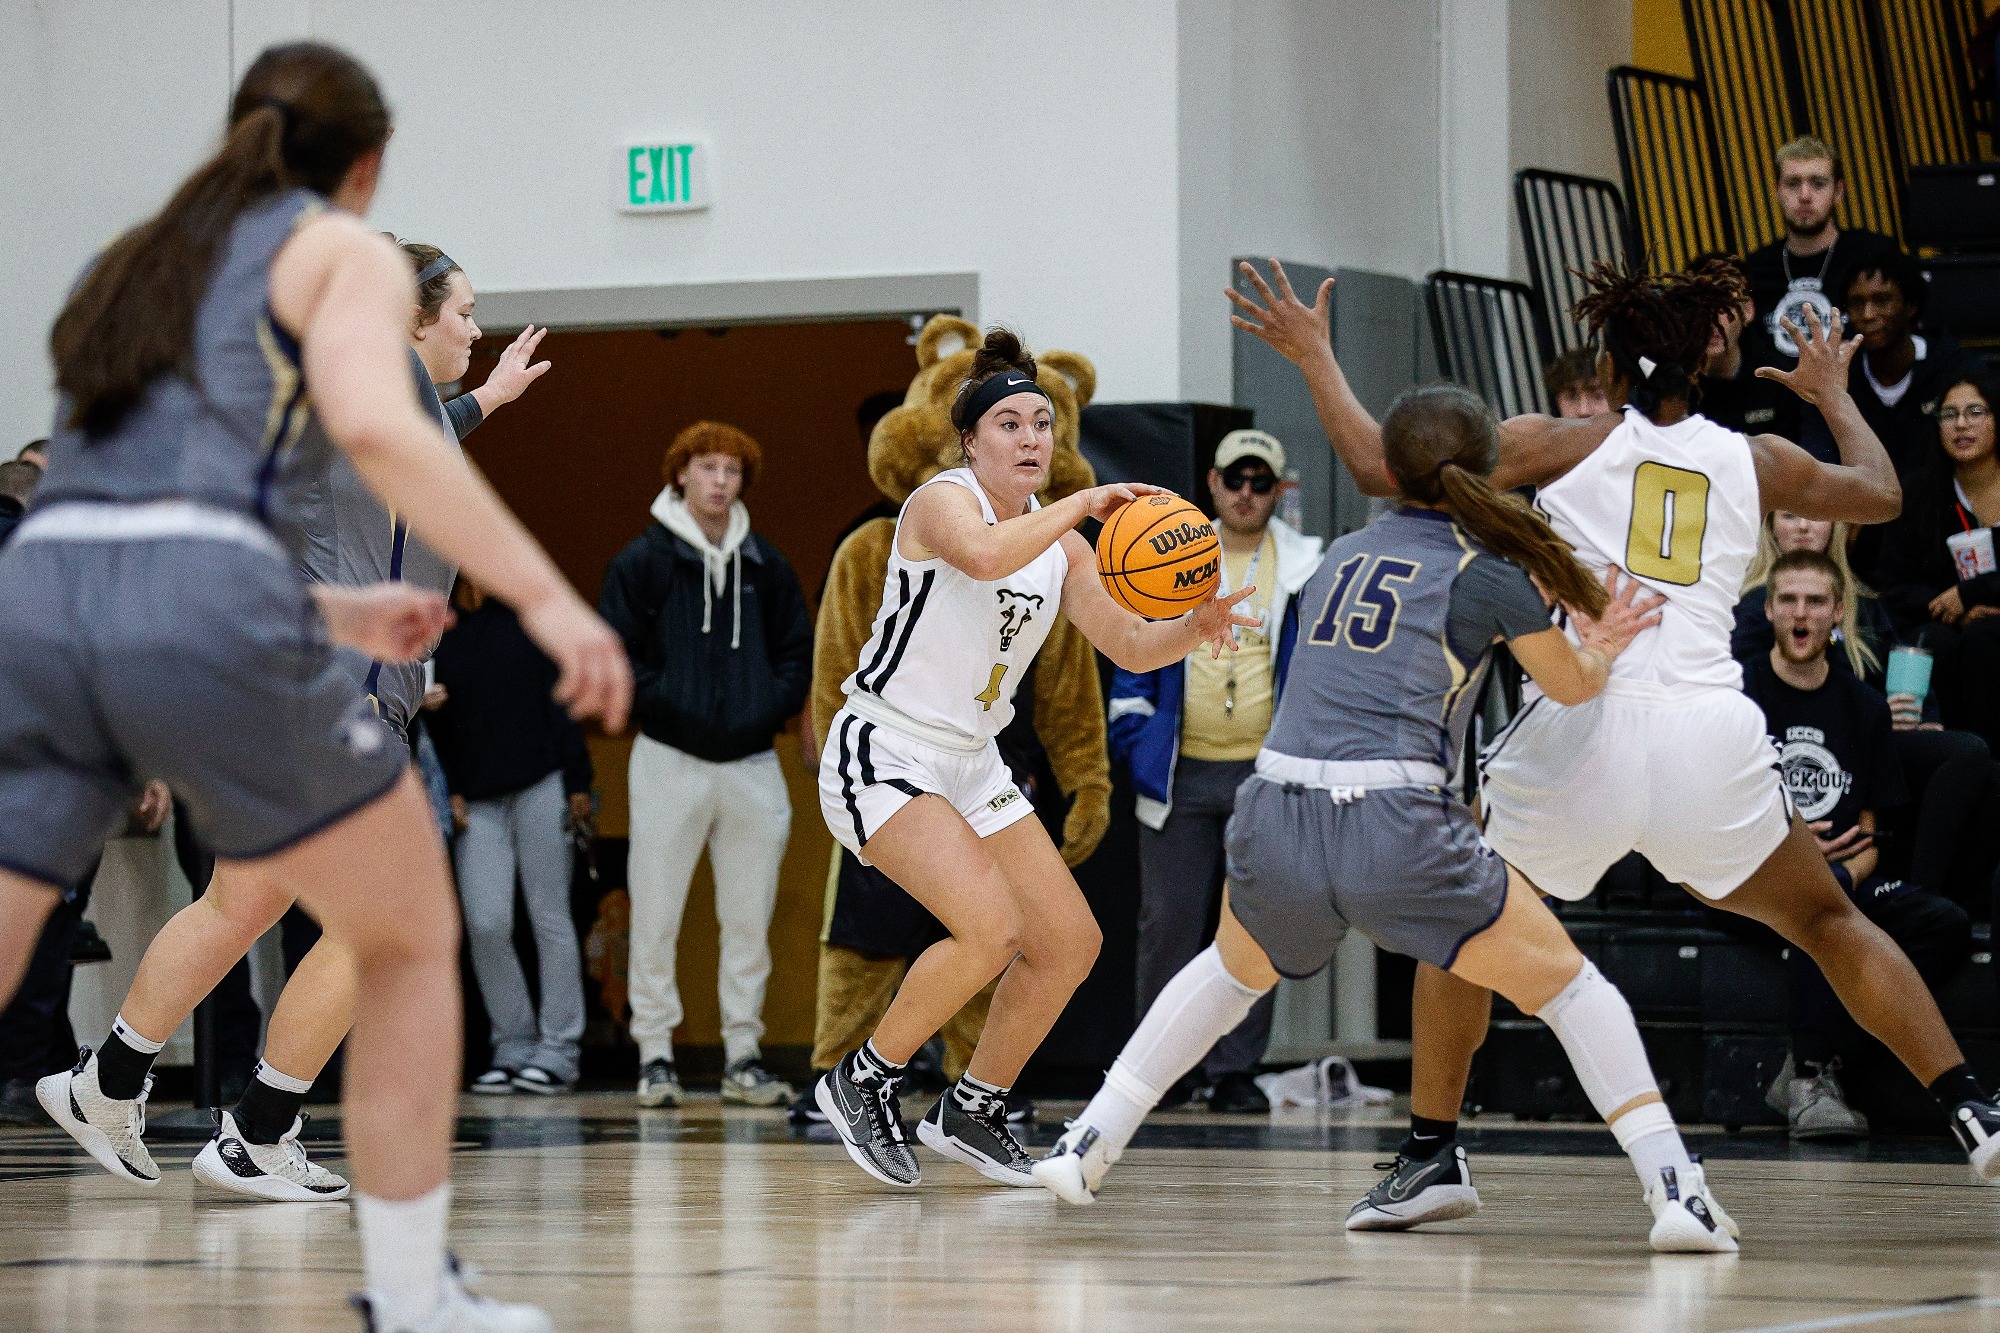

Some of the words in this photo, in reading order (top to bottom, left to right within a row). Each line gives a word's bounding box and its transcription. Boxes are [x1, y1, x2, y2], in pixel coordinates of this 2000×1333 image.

[628, 144, 694, 205] EXIT
[1148, 522, 1216, 555] Wilson
[1625, 460, 1711, 586] 0
[1173, 554, 1219, 589] NCAA
[1307, 552, 1423, 654] 15
[986, 788, 1021, 813] UCCS
